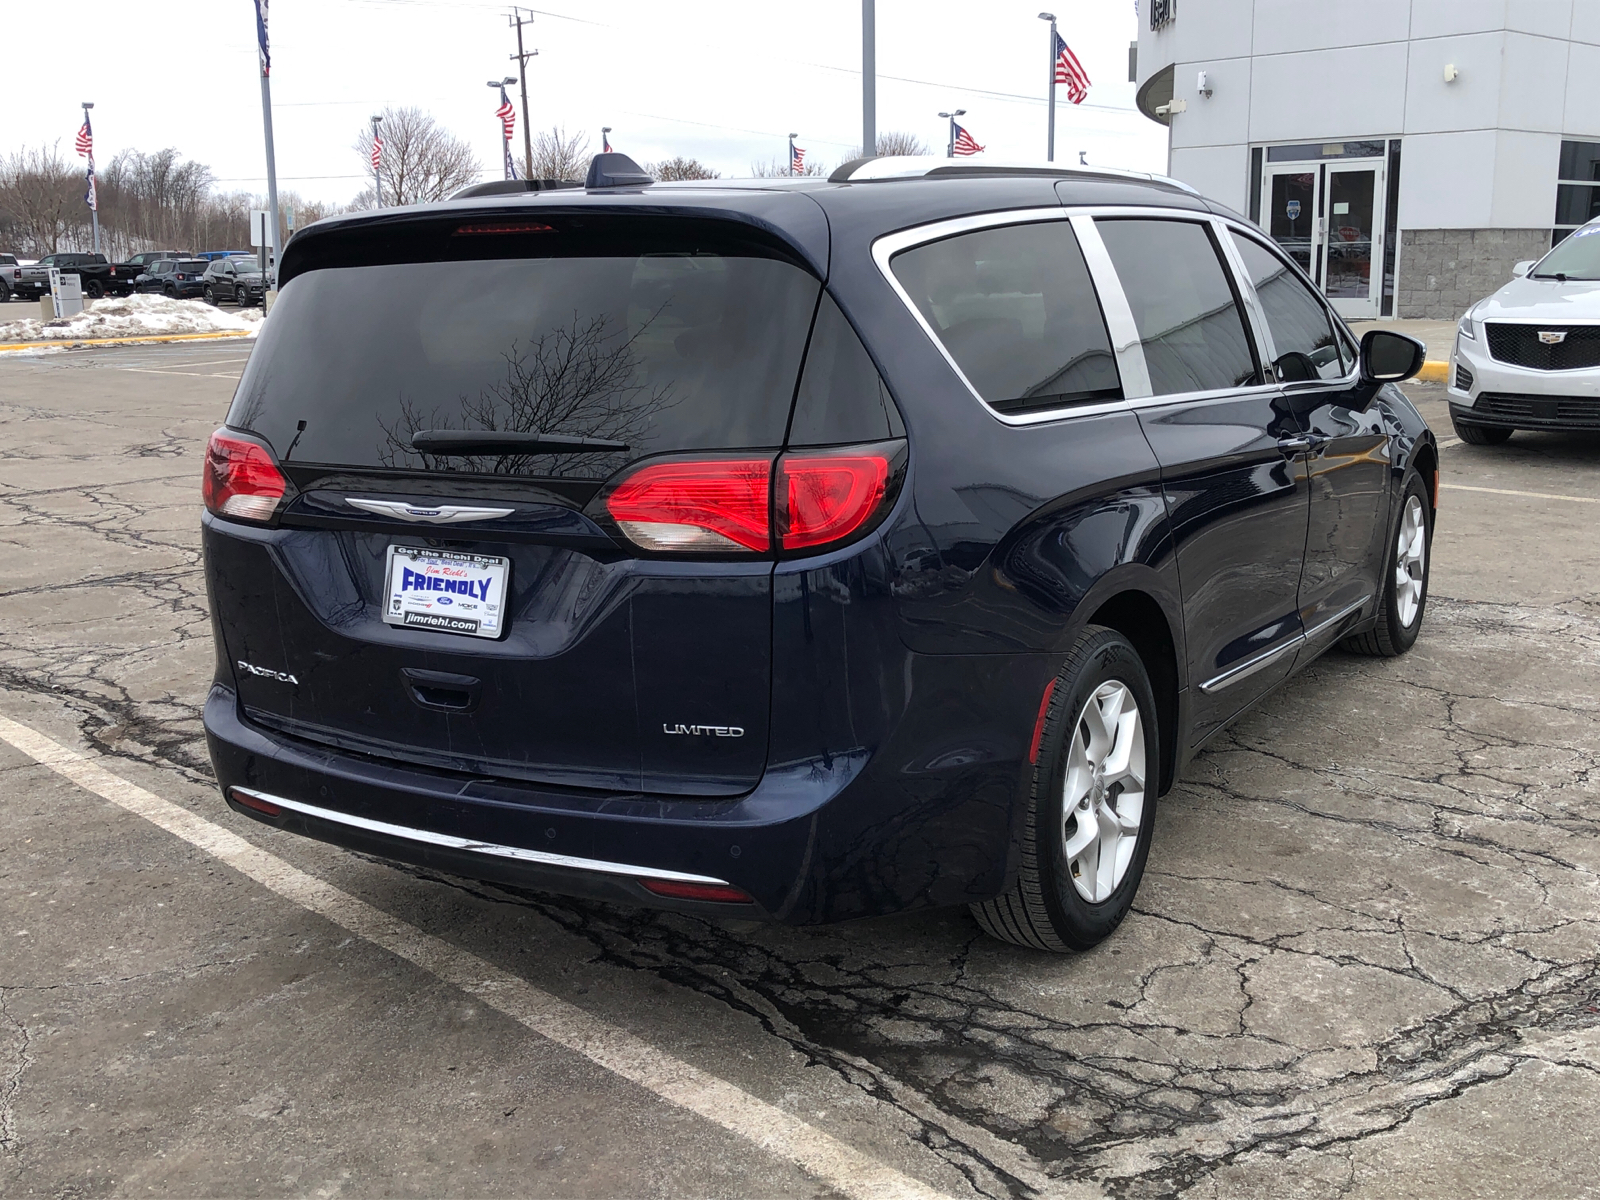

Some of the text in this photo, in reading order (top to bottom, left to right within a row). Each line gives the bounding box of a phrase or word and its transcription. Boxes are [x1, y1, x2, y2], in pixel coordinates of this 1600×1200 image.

[424, 566, 468, 577] Jim Riehl's
[402, 566, 492, 602] FRIENDLY
[406, 614, 476, 630] jimriehl.com
[237, 660, 299, 685] PACIFICA
[663, 723, 745, 737] LIMITED
